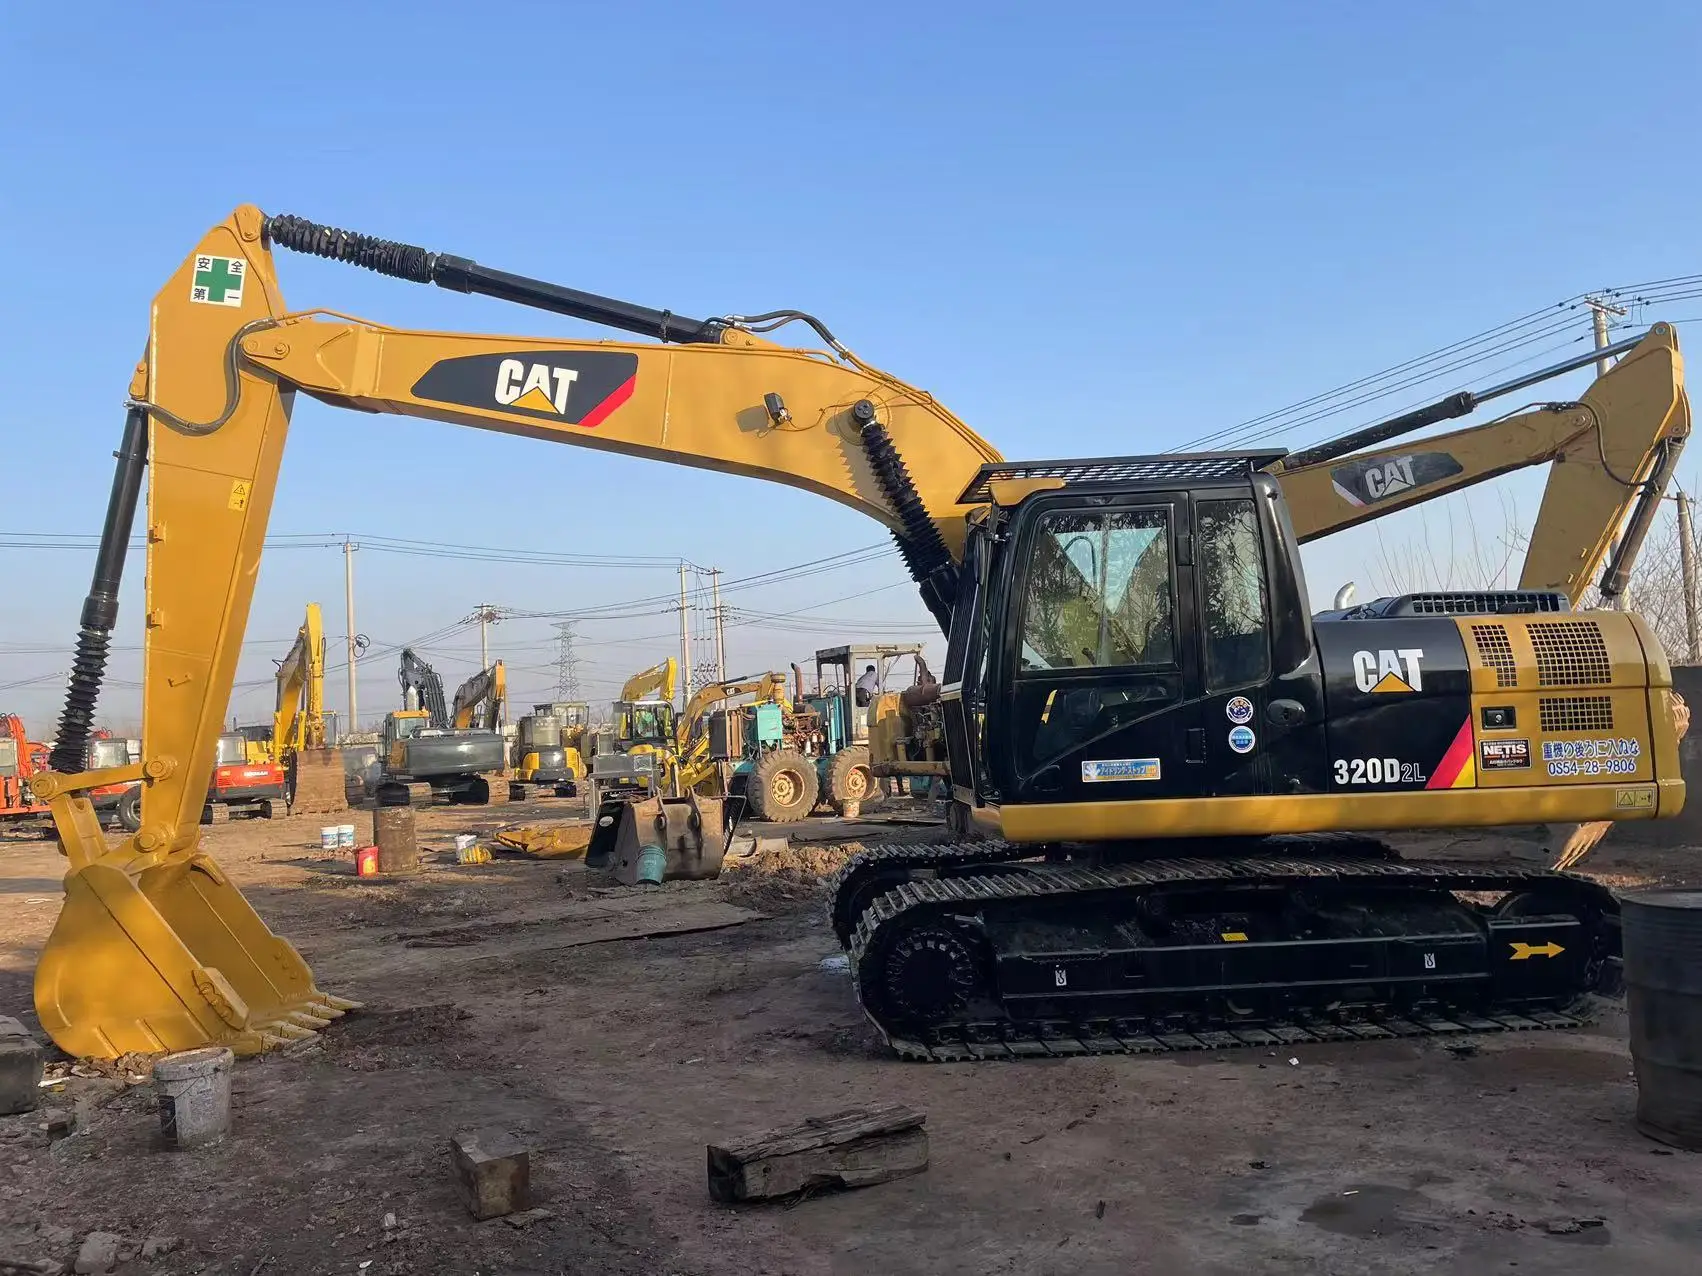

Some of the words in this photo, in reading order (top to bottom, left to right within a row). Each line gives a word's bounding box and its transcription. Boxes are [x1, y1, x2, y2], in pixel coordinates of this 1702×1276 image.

[197, 257, 210, 270] 安
[231, 261, 243, 273] 全
[193, 288, 206, 300] 第
[495, 359, 578, 415] CAT
[1365, 455, 1416, 499] CAT
[1353, 649, 1424, 693] CAT
[1483, 744, 1527, 755] NETIS
